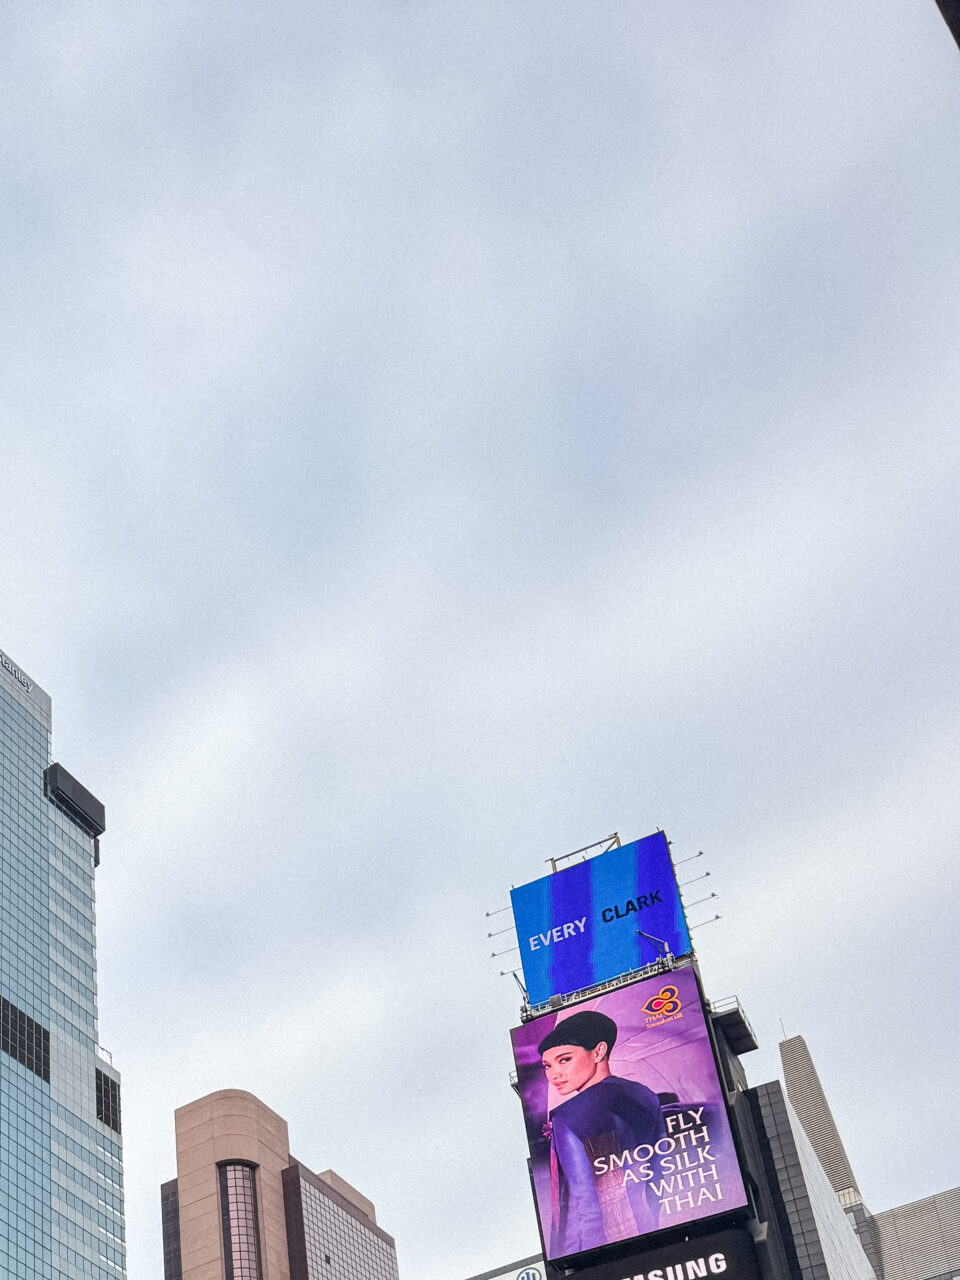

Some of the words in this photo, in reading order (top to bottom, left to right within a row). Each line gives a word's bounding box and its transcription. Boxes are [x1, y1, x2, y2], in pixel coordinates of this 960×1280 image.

[529, 917, 587, 951] EVERY
[601, 890, 663, 923] CLARK
[665, 1106, 704, 1134] FLY
[593, 1125, 710, 1175] SMOOTH
[622, 1158, 654, 1188] AS
[660, 1144, 716, 1175] SILK
[649, 1164, 720, 1198] WITH
[658, 1183, 724, 1216] THAI
